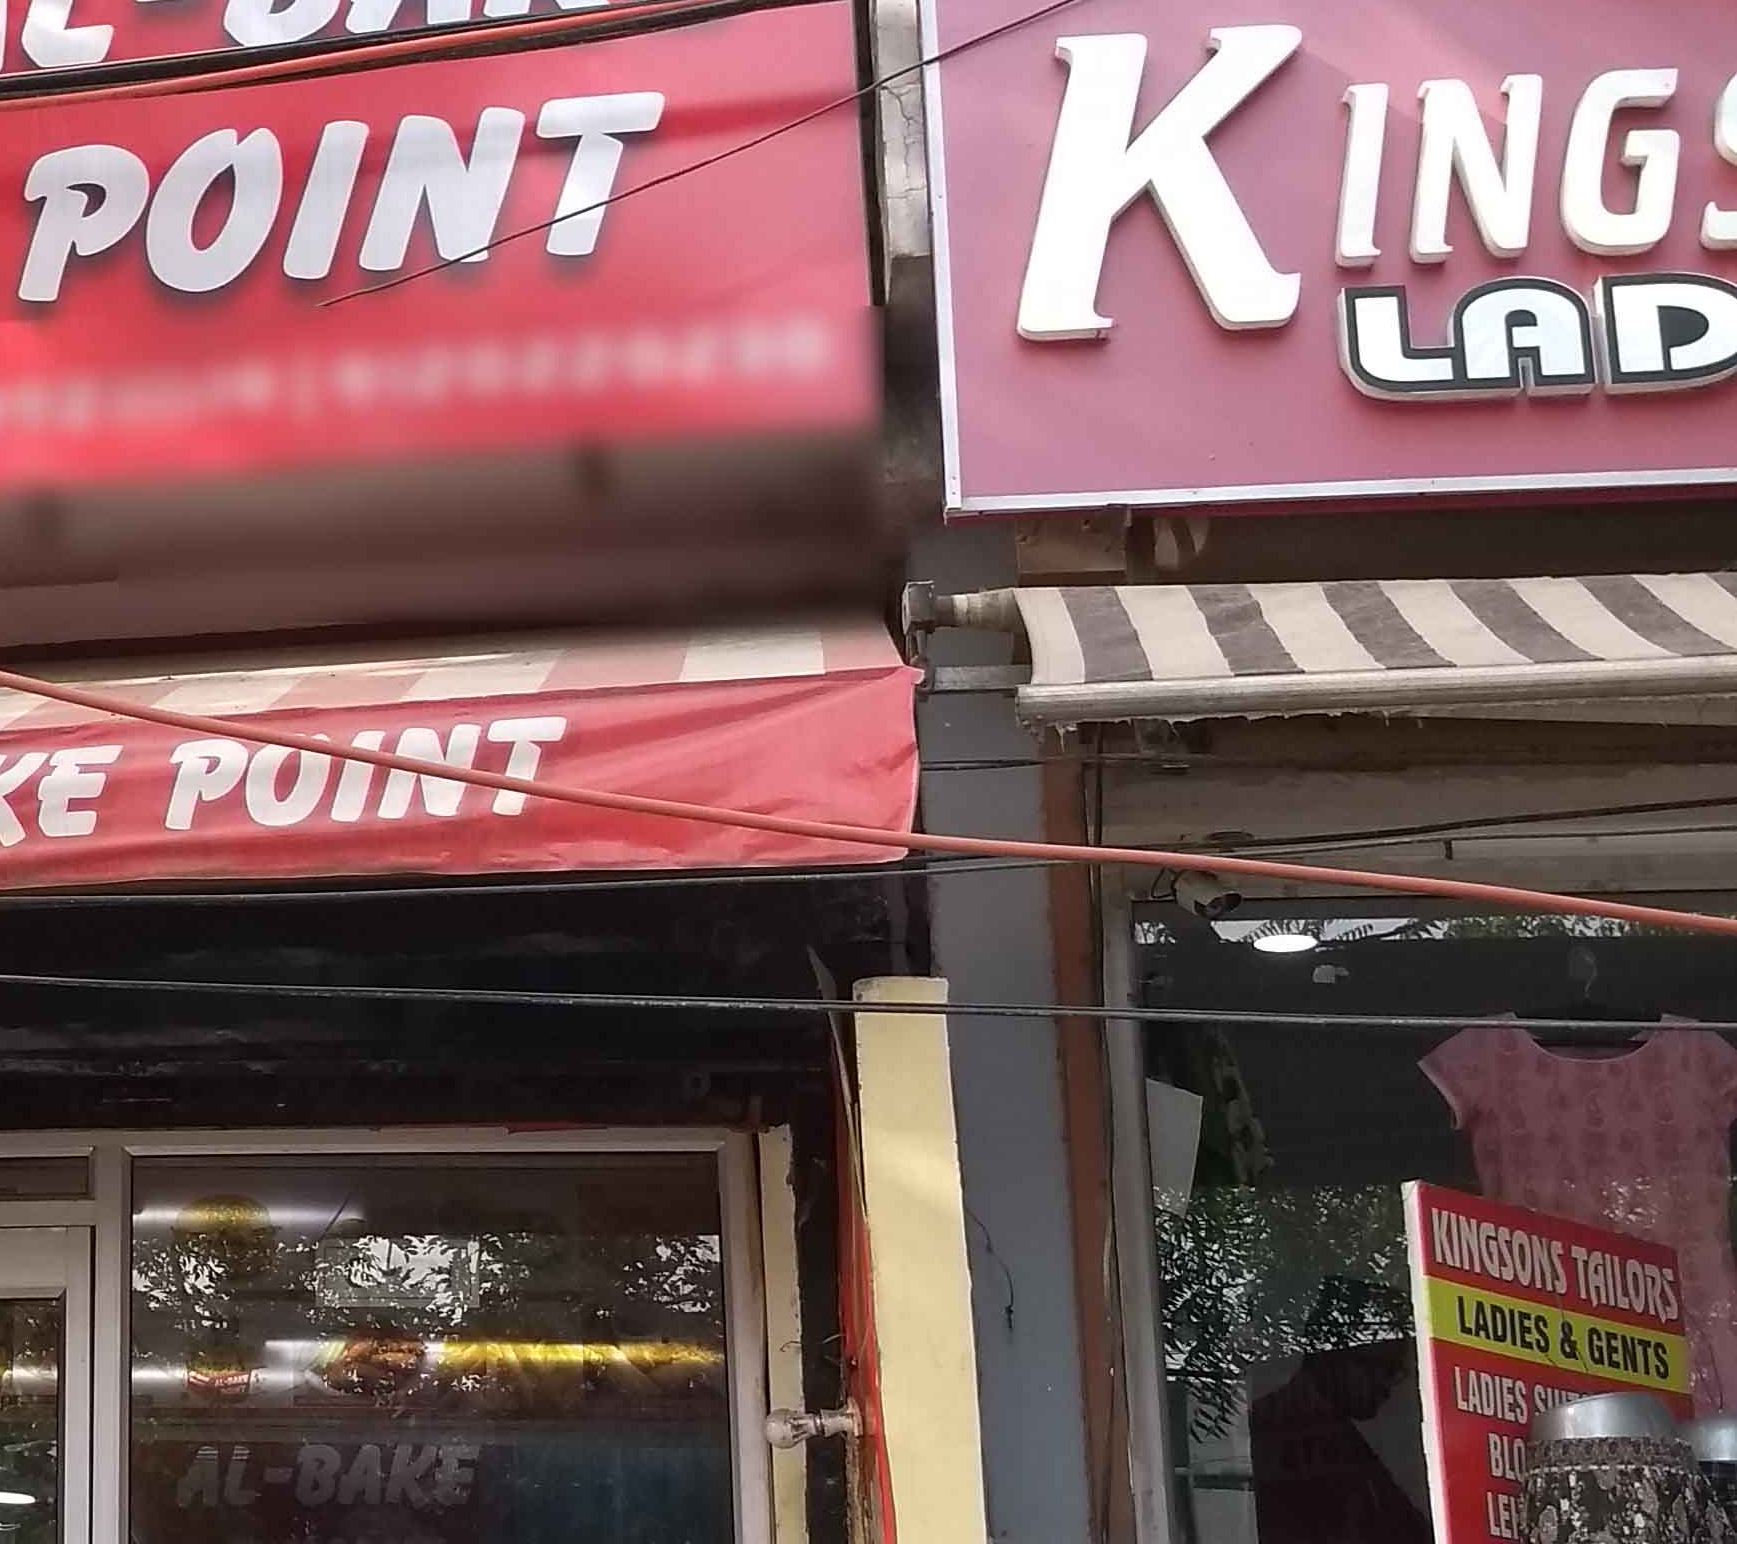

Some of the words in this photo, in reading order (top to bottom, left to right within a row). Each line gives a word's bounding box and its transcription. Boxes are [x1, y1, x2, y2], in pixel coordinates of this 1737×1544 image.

[18, 92, 666, 304] POINT
[164, 716, 568, 832] POINT
[1430, 1207, 1567, 1296] KINGSONS
[1571, 1246, 1679, 1325] TAILORS
[1457, 1295, 1550, 1354] LADIES
[1560, 1321, 1578, 1360] &
[1588, 1327, 1670, 1380] GENTS
[1454, 1366, 1528, 1425] LADIES
[176, 1443, 480, 1506] AL-BAKE
